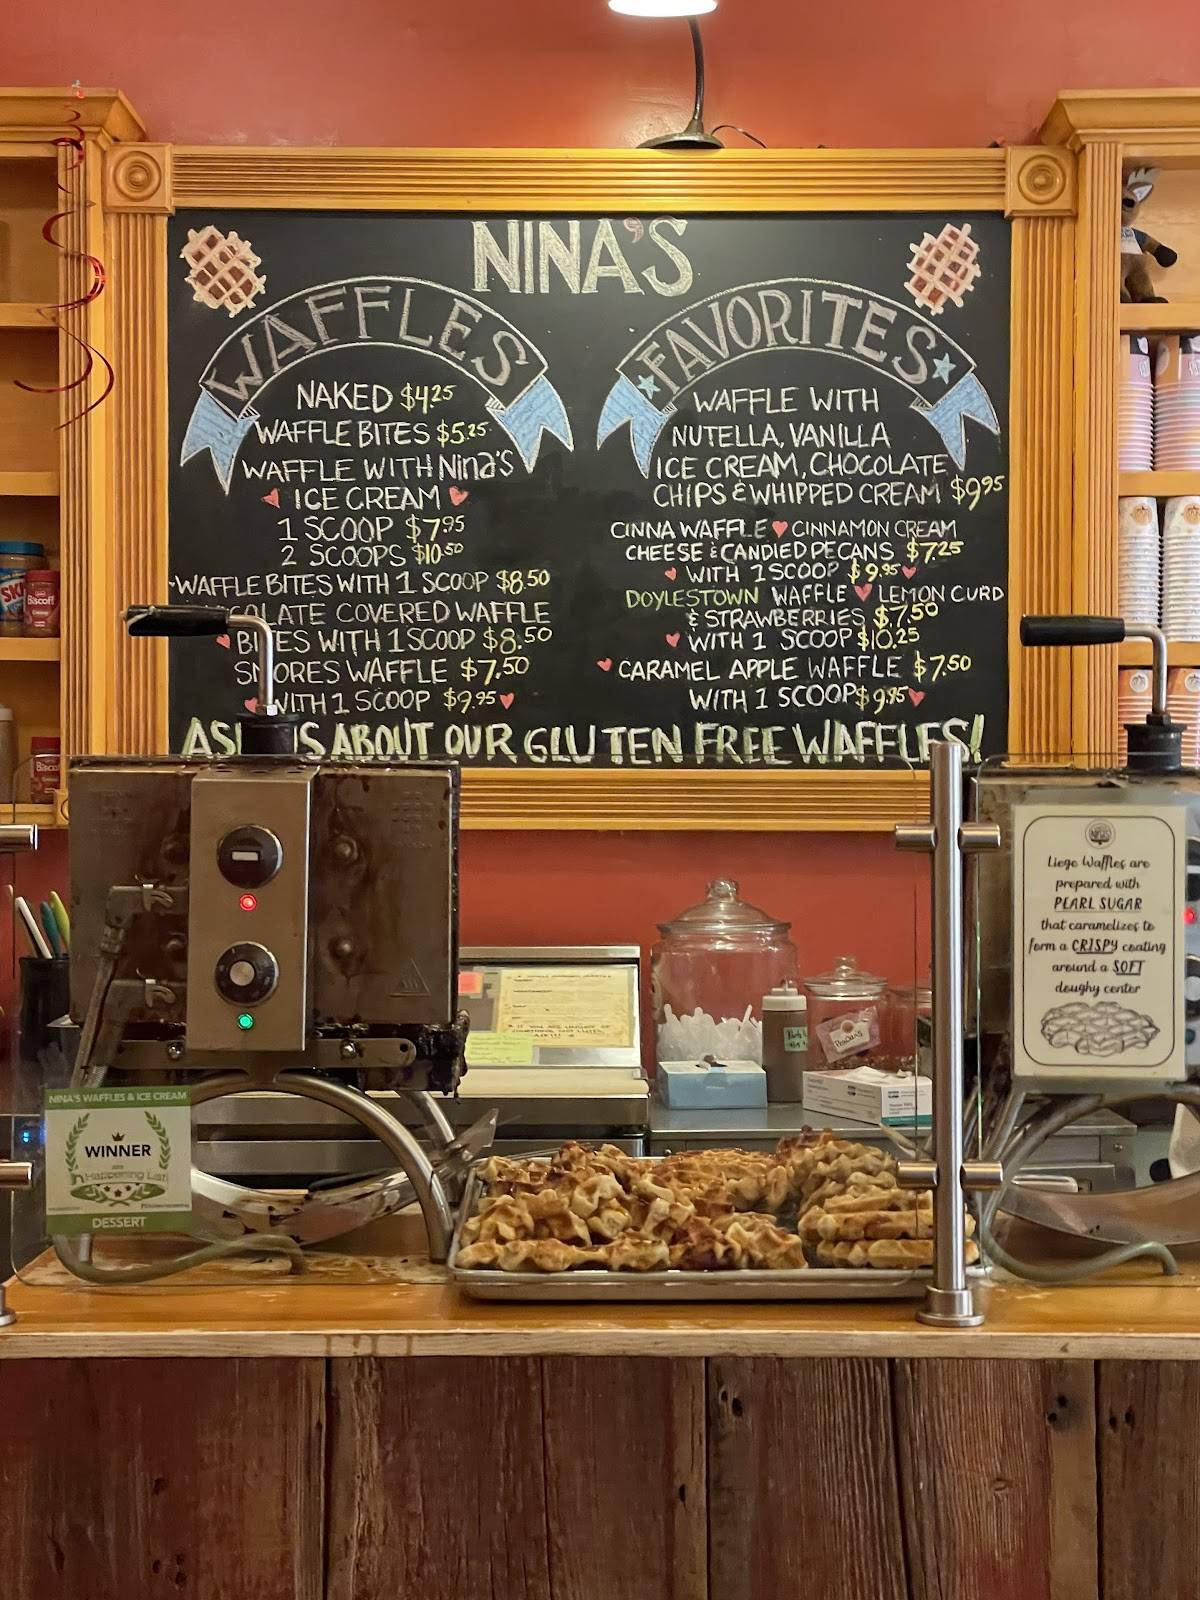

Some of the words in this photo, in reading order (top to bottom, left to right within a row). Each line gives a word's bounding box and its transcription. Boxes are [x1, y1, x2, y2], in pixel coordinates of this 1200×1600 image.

[472, 217, 693, 297] NINA'S
[206, 286, 528, 400] WAFFLES
[636, 290, 936, 394] FAVORITES
[297, 381, 393, 413] NAKED
[693, 386, 799, 415] WAFFLE
[809, 387, 880, 414] WITH
[255, 419, 351, 447] WAFFLE
[359, 420, 430, 446] BITES
[672, 422, 785, 449] NUTELLA,
[791, 421, 892, 449] VANILLA
[242, 458, 355, 483] WAFFLE
[364, 454, 433, 482] WITH
[439, 449, 514, 482] Nina's
[656, 456, 696, 479] ICE
[705, 454, 807, 480] CREAM,
[810, 452, 948, 477] CHOCOLATE
[295, 486, 341, 511] ICE
[345, 484, 441, 511] CREAM
[653, 482, 727, 509] CHIPS
[749, 481, 853, 507] WHIPPED
[858, 480, 941, 507] CREAM
[276, 517, 298, 542] 1
[304, 516, 394, 542] SCOOP
[610, 520, 676, 540] CINNA
[680, 518, 767, 540] WAFFLE
[791, 518, 890, 540] CINNAMON
[894, 519, 958, 539] CREAM
[280, 545, 297, 567] 2
[309, 544, 406, 567] SCOOPS
[625, 542, 704, 563] CHEESE
[720, 541, 807, 564] CANDIED
[810, 541, 895, 562] PECANS
[175, 573, 263, 598] WAFFLE
[265, 573, 334, 597] BITES
[336, 572, 390, 596] WITH
[395, 571, 417, 594] 1
[423, 571, 489, 594] SCOOP
[495, 569, 551, 595] $8.50
[686, 562, 740, 584] WITH
[753, 563, 766, 584] 1
[771, 561, 840, 580] SCOOP
[847, 556, 902, 584] $9.95
[625, 587, 760, 609] DOYLESTOWN
[771, 585, 847, 607] WAFFLE
[878, 584, 946, 604] LEMON
[950, 585, 1005, 603] CURD
[336, 600, 451, 624] COVERED
[455, 601, 551, 624] WAFFLE
[705, 607, 866, 629] STRAWBERRIES
[318, 628, 381, 657] WITH
[388, 628, 405, 653] 1
[407, 627, 476, 651] SCOOP
[482, 626, 553, 655] $8.50
[687, 630, 744, 653] WITH
[753, 630, 767, 650] 1
[779, 627, 853, 651] SCOOP
[857, 624, 920, 652] $10.25
[347, 657, 448, 685] WAFFLE
[460, 656, 530, 686] $7.50
[618, 658, 720, 682] CARAMEL
[728, 656, 799, 682] APPLE
[808, 655, 902, 680] WAFFLE
[913, 650, 972, 683] $7.50
[332, 692, 350, 715] 1
[355, 688, 431, 712] SCOOP
[442, 687, 497, 714] $9.95
[689, 687, 747, 713] WITH
[755, 687, 767, 709] 1
[778, 682, 856, 709] SCOOP
[331, 715, 435, 762] ABOUT
[444, 720, 518, 764] OUR
[695, 720, 793, 766] FREE
[1047, 855, 1078, 869] Liege
[1082, 853, 1126, 871] Waffles
[1129, 860, 1151, 869] are
[1055, 877, 1112, 893] prepared
[1115, 877, 1140, 889] with
[1054, 896, 1095, 910] PEARL
[1099, 896, 1143, 911] SUGAR
[1040, 918, 1066, 931] that
[1068, 918, 1139, 932] caramelizes
[1142, 919, 1156, 931] to
[1027, 937, 1056, 955] form
[1059, 943, 1067, 951] a
[1072, 938, 1119, 953] CRISPY
[1122, 942, 1167, 955] coating
[1052, 960, 1097, 973] around
[1100, 965, 1108, 973] a
[1112, 959, 1145, 974] SOFT
[1055, 982, 1100, 997] doughy
[1103, 982, 1141, 994] center
[49, 1094, 81, 1104] NINA'S
[82, 1092, 126, 1103] WAFFLES
[127, 1092, 136, 1102] &
[136, 1092, 151, 1101] ICE
[152, 1091, 187, 1100] CREAM
[84, 1144, 152, 1158] WINNER
[91, 1216, 147, 1229] DESSERT
